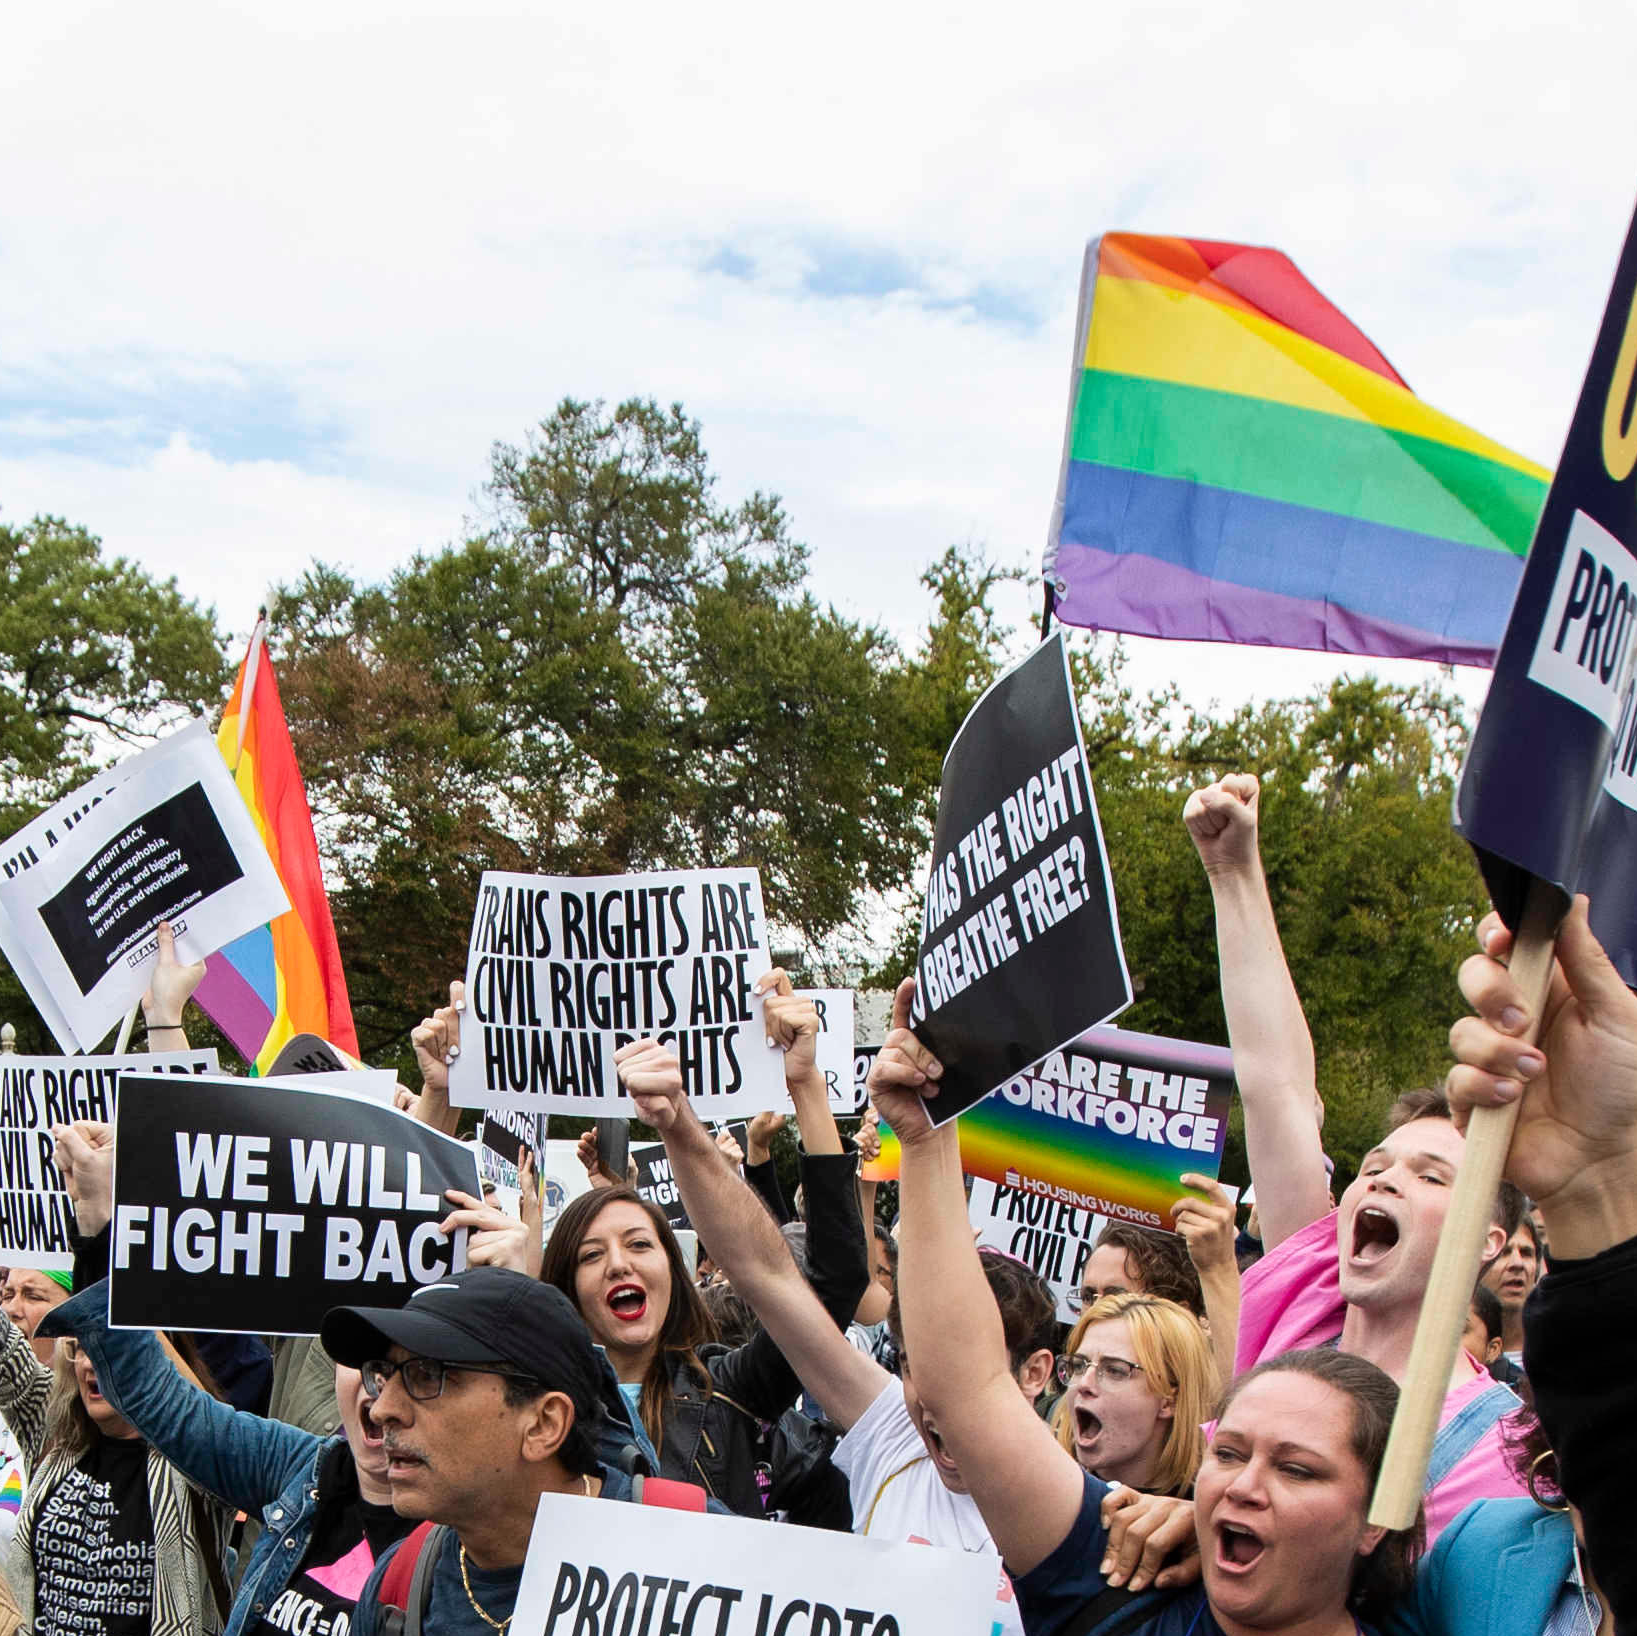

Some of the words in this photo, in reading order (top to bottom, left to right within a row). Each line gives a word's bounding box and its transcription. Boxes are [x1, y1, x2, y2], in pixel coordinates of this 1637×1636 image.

[85, 864, 99, 881] WE
[98, 844, 120, 870] FIGHT
[120, 825, 146, 849] BACK
[111, 838, 169, 880] transphobia,
[132, 866, 150, 886] and
[149, 848, 181, 873] bigotry
[928, 850, 960, 932] HAS
[960, 812, 1006, 896] THE
[1002, 745, 1084, 862] RIGHT
[128, 889, 145, 908] and
[475, 885, 550, 959] TRANS
[561, 885, 690, 960] RIGHTS
[701, 882, 759, 953] ARE
[923, 895, 1019, 1016] BREATHE
[1013, 835, 1090, 943] FREE?
[127, 937, 160, 967] HEALT
[474, 956, 541, 1027] CIVIL
[549, 959, 677, 1030] RIGHTS
[689, 953, 753, 1026] ARE
[484, 1026, 604, 1098] HUMAN
[1042, 1051, 1122, 1098] ARE
[1127, 1067, 1209, 1114] THE
[988, 1076, 1219, 1153] ORKFORCE
[175, 1131, 271, 1201] WE
[290, 1138, 440, 1212] WILL
[1023, 1176, 1097, 1209] HOUSING
[1098, 1199, 1161, 1225] WORKS
[115, 1204, 305, 1279] FIGHT
[990, 1183, 1095, 1241] PROTECT
[1010, 1226, 1065, 1283] CIVIL
